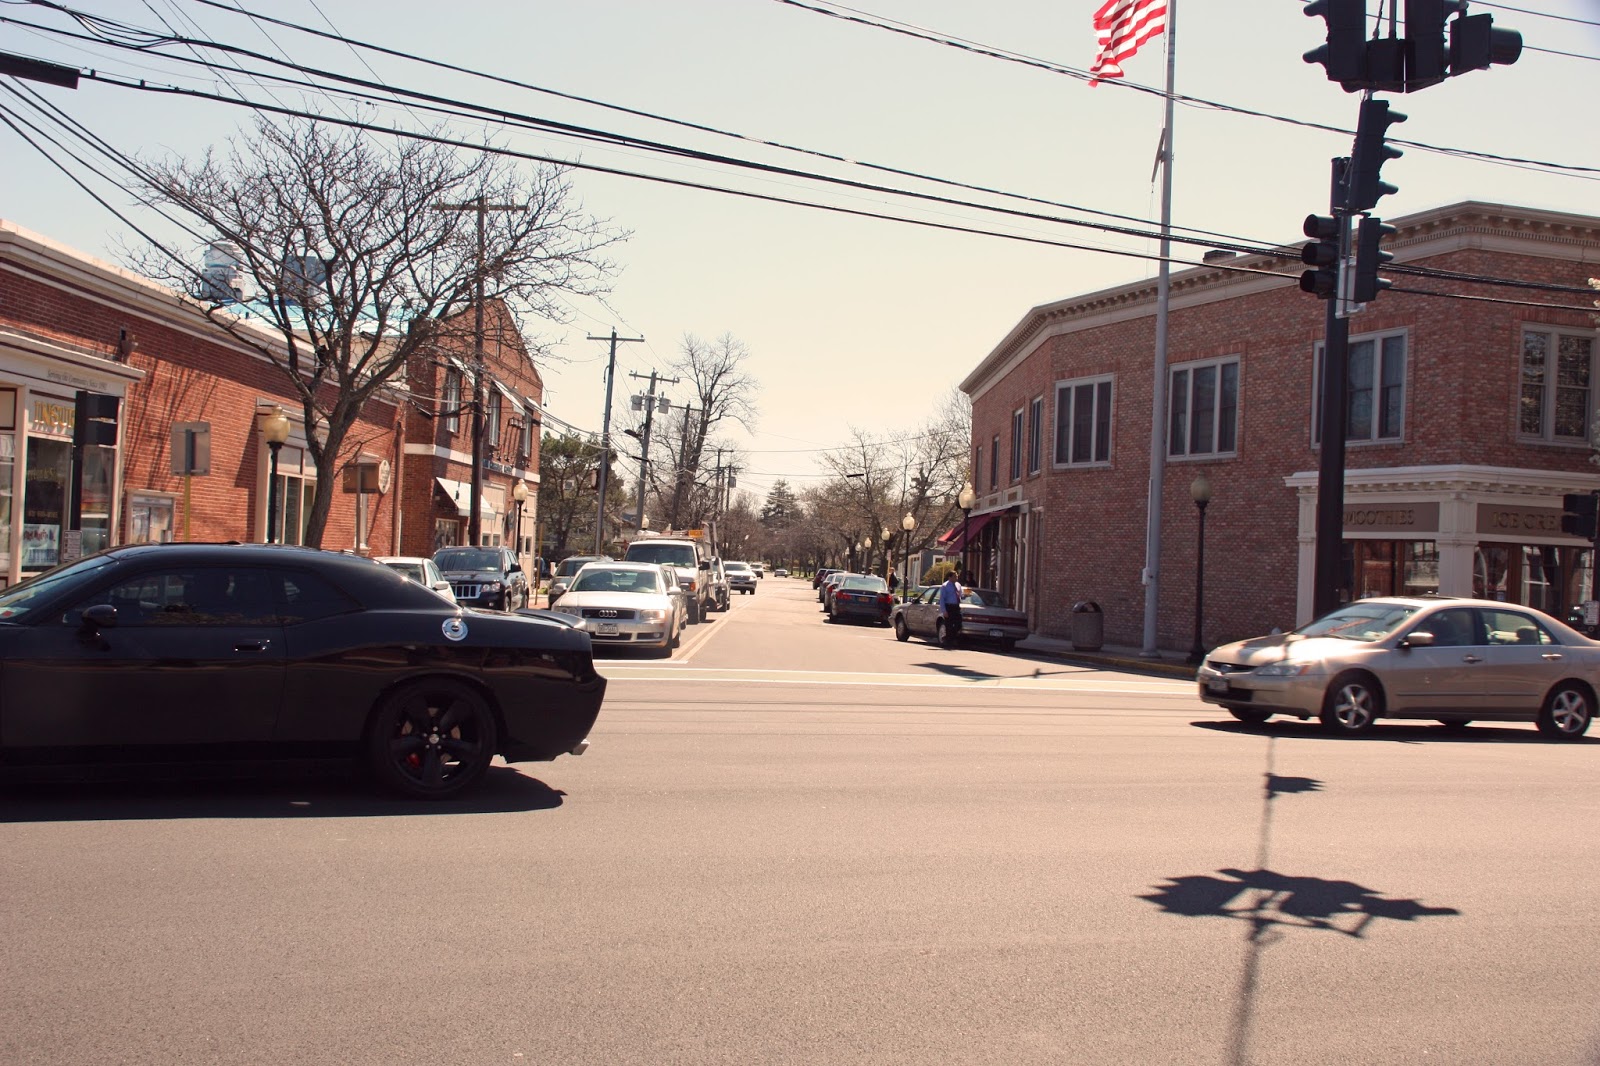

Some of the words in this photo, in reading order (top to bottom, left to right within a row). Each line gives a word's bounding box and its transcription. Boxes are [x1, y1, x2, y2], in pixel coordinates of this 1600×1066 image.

[1343, 509, 1415, 526] MOOTHIES
[1491, 511, 1519, 529] ICE
[1523, 513, 1562, 531] CRE
